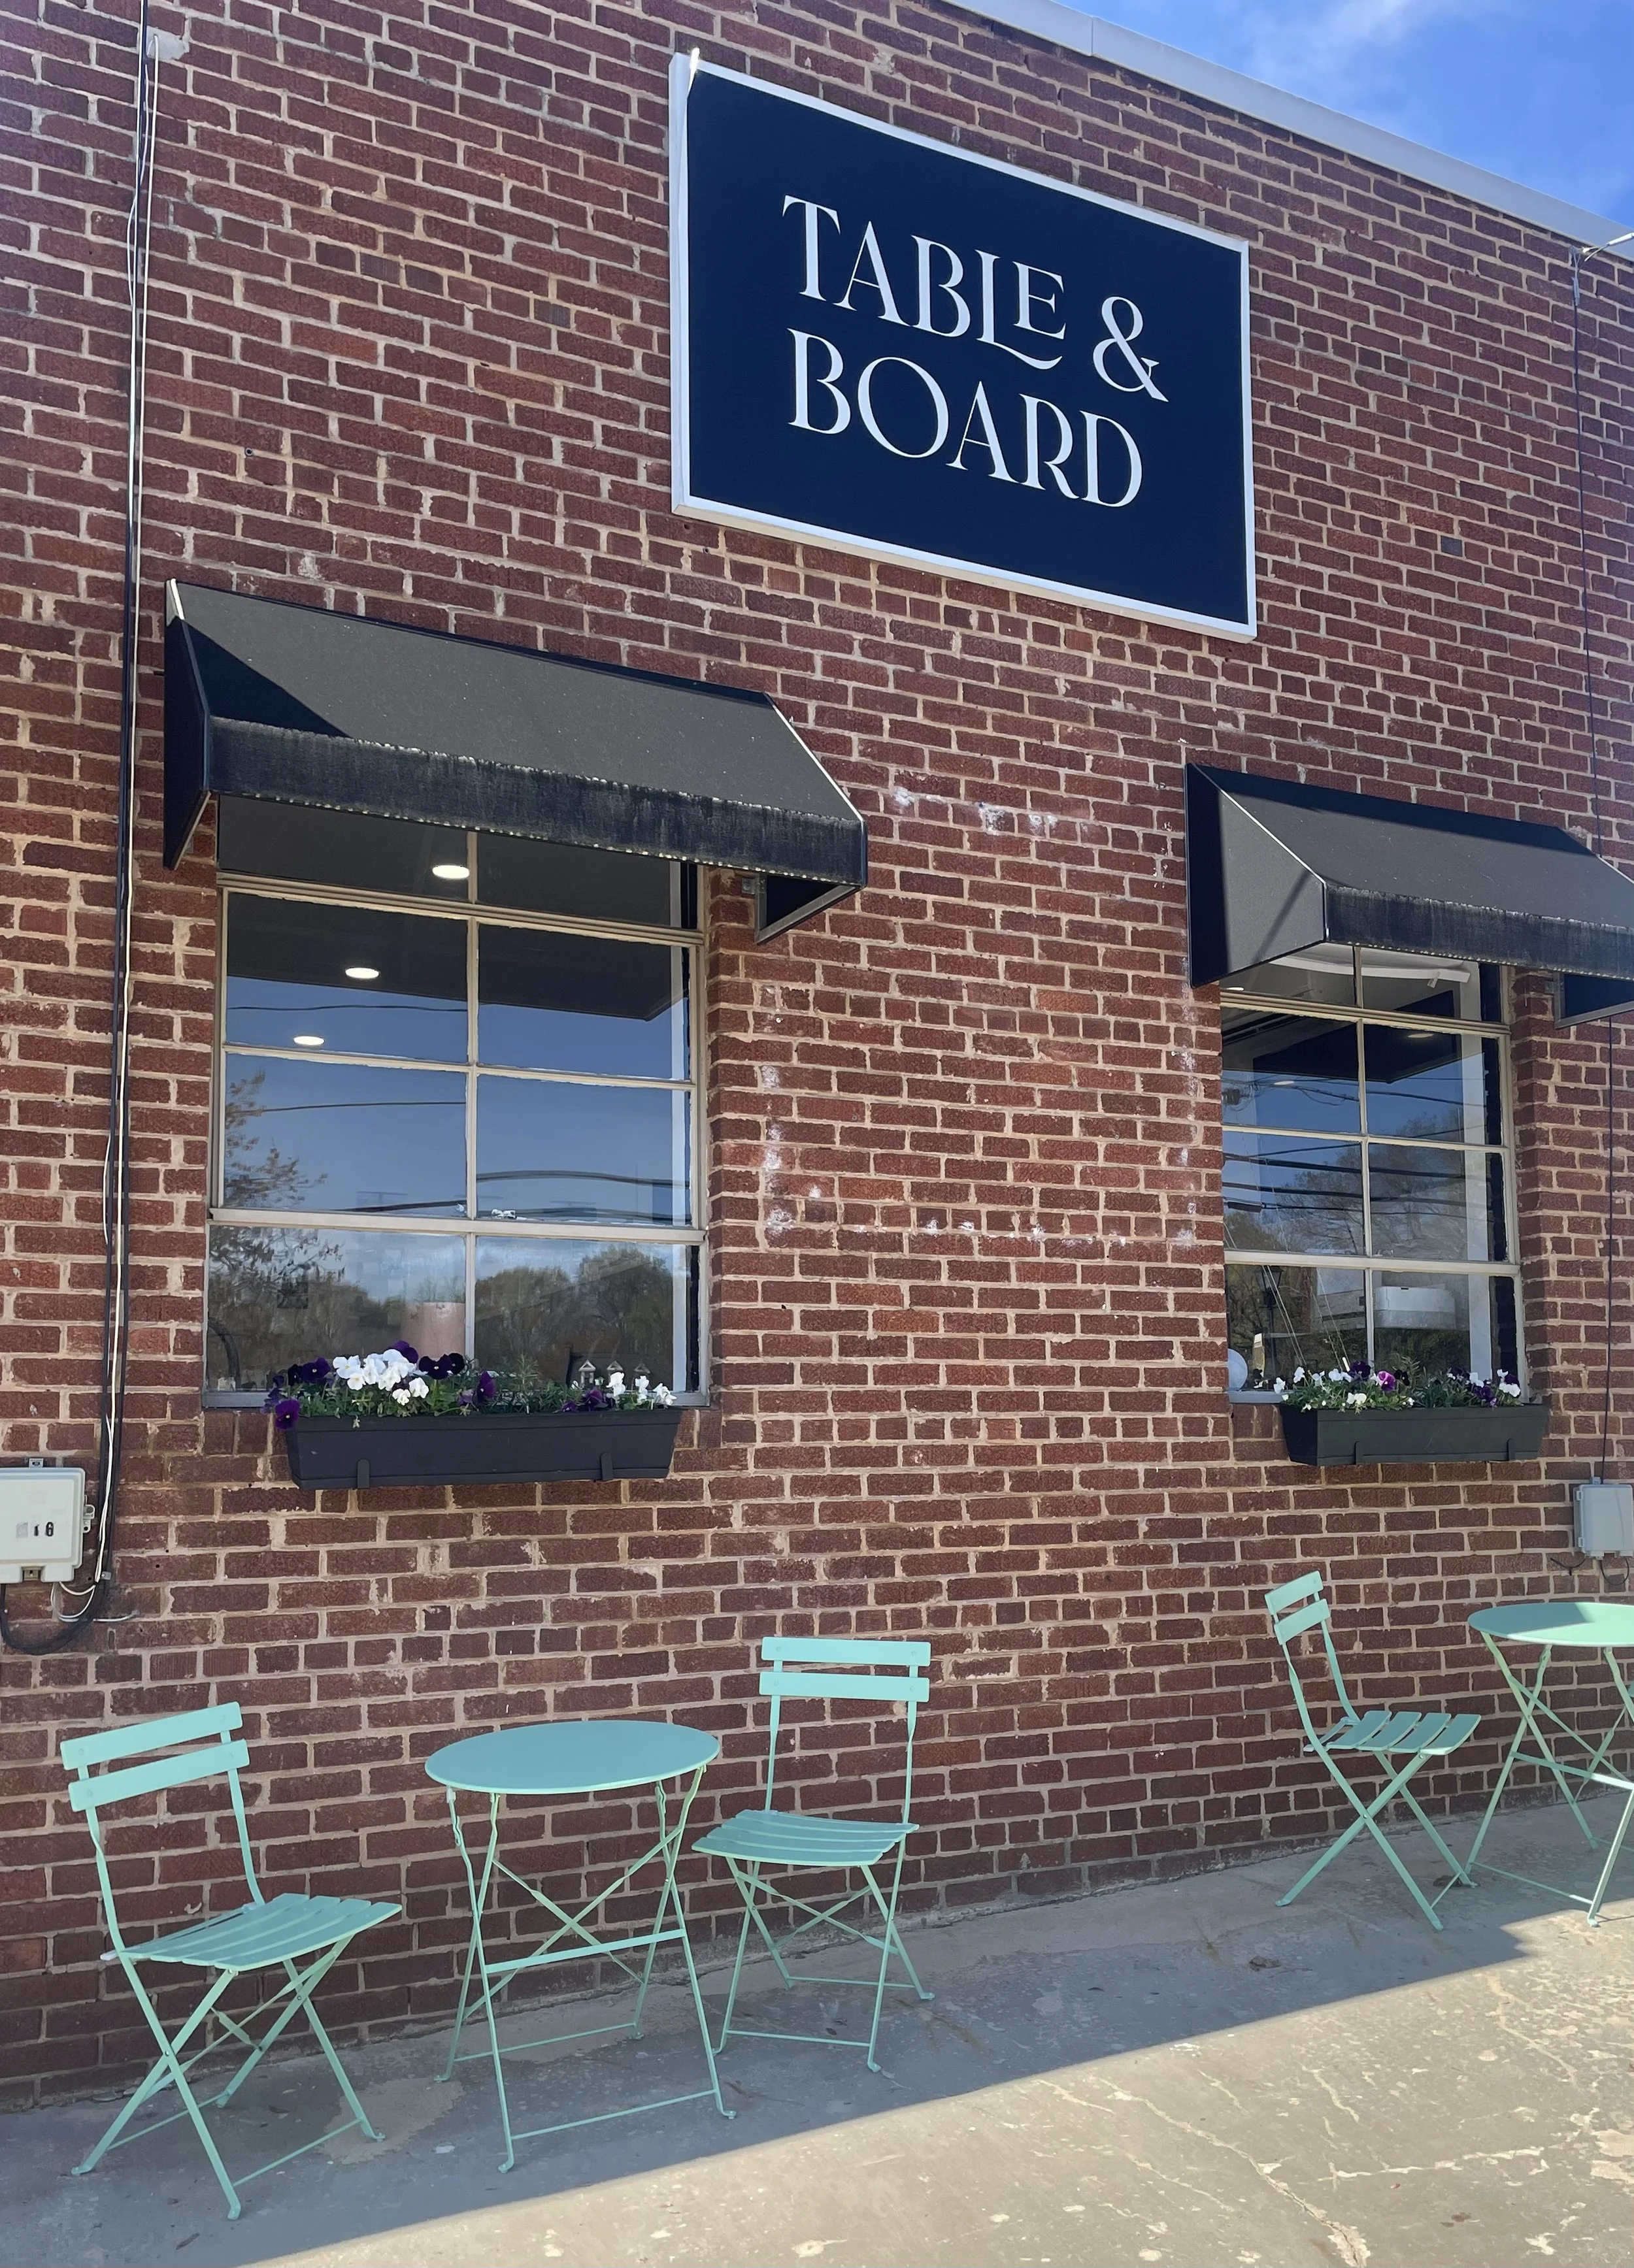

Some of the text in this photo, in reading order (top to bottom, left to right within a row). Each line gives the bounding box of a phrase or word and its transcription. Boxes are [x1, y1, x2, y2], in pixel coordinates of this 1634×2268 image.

[782, 195, 1169, 403] TABLE &
[787, 328, 1142, 507] BOARD
